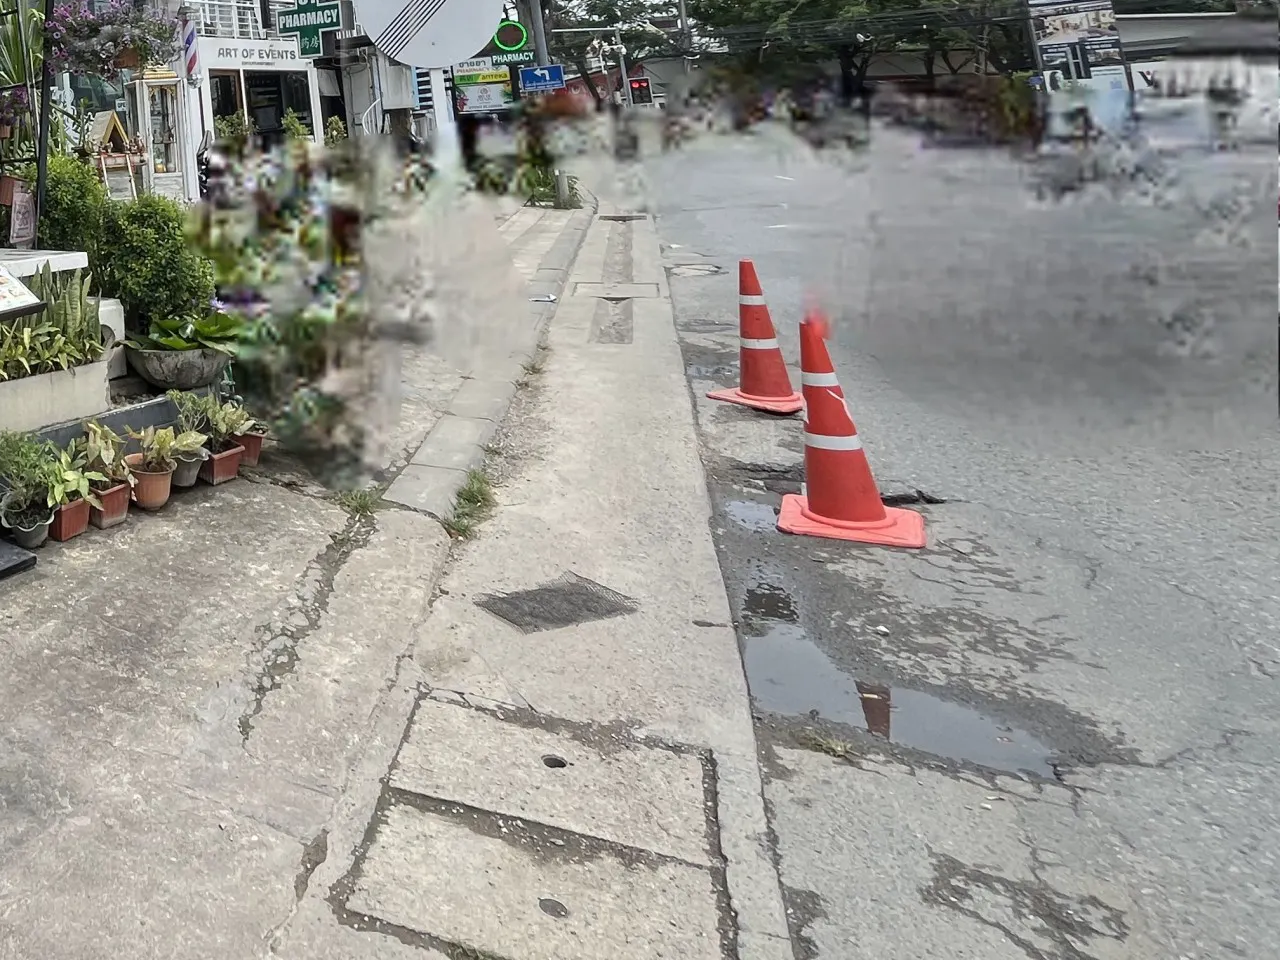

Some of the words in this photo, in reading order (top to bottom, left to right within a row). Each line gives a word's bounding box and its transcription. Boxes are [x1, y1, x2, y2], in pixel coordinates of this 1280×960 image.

[279, 8, 338, 28] PHARMACY
[218, 48, 238, 58] ART
[241, 48, 255, 58] OF
[258, 48, 296, 59] EVENTS
[492, 51, 534, 63] PHARMACY
[481, 71, 508, 80] аптека
